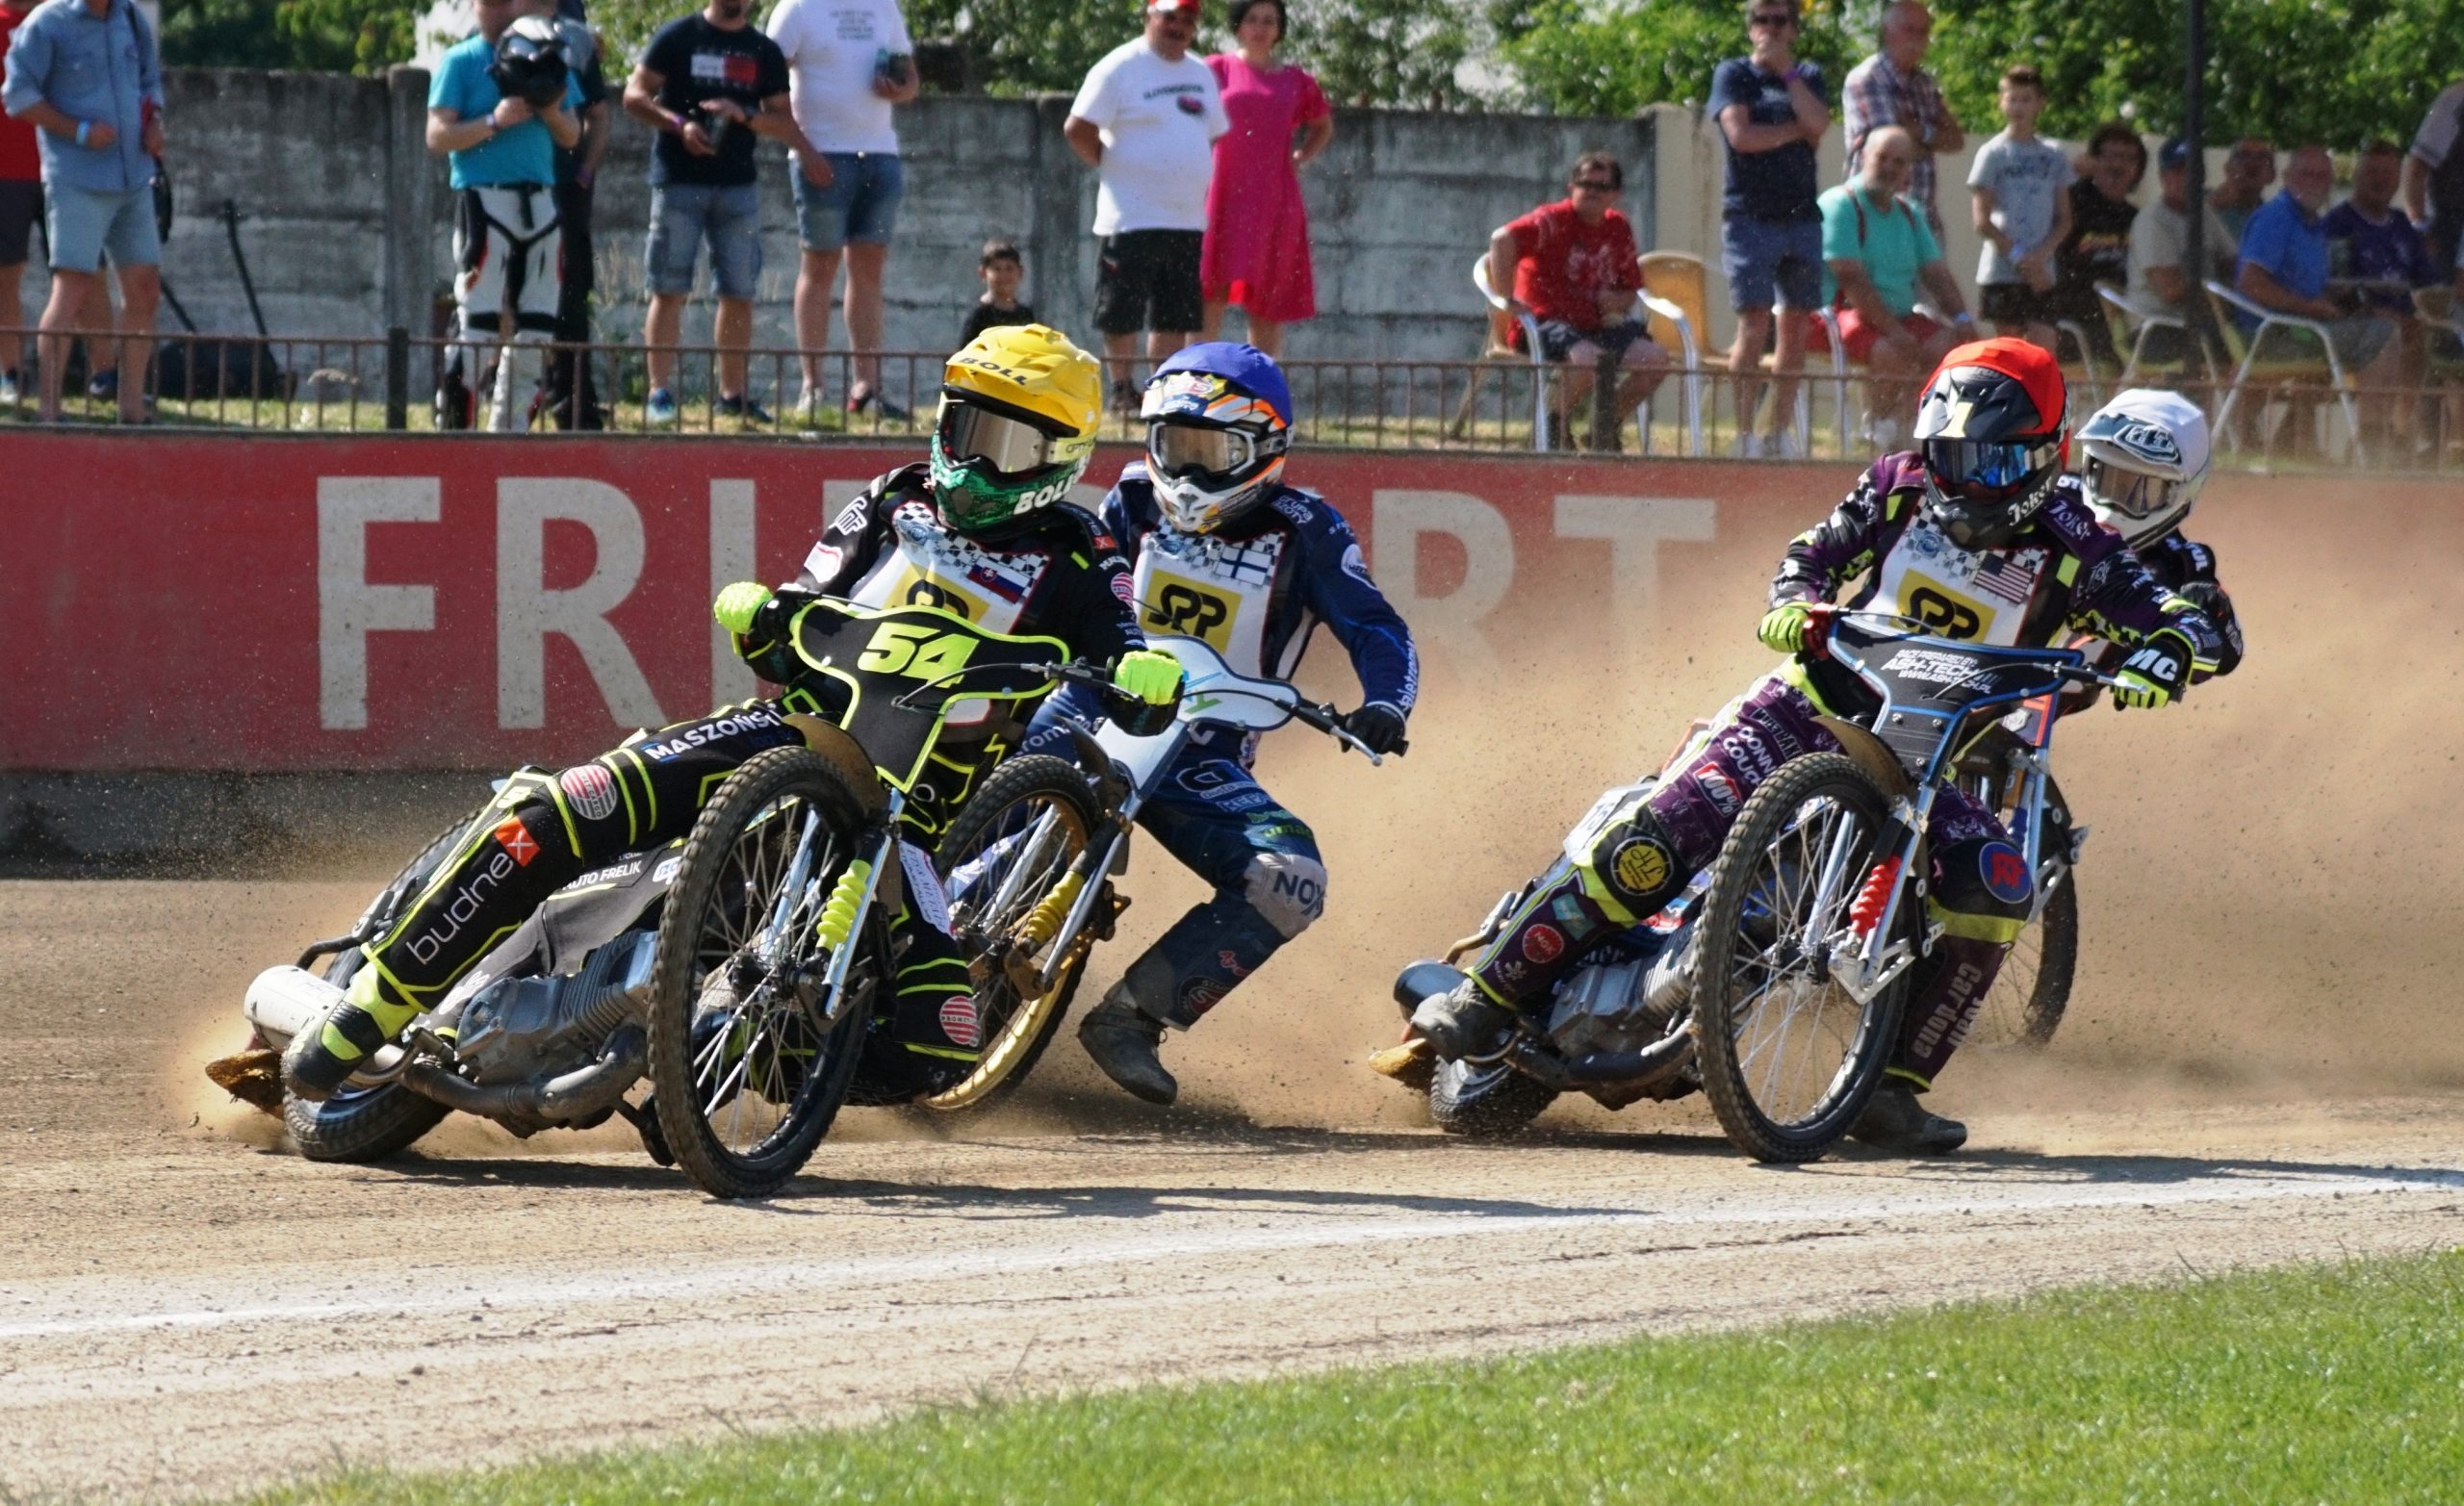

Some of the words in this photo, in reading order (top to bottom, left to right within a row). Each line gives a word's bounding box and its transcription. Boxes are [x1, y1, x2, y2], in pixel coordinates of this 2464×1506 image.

[961, 357, 1029, 385] BOLL
[857, 622, 981, 689] 54
[1737, 727, 1777, 775] DONN
[1697, 769, 1741, 816] 100%
[599, 860, 642, 881] FRELIK
